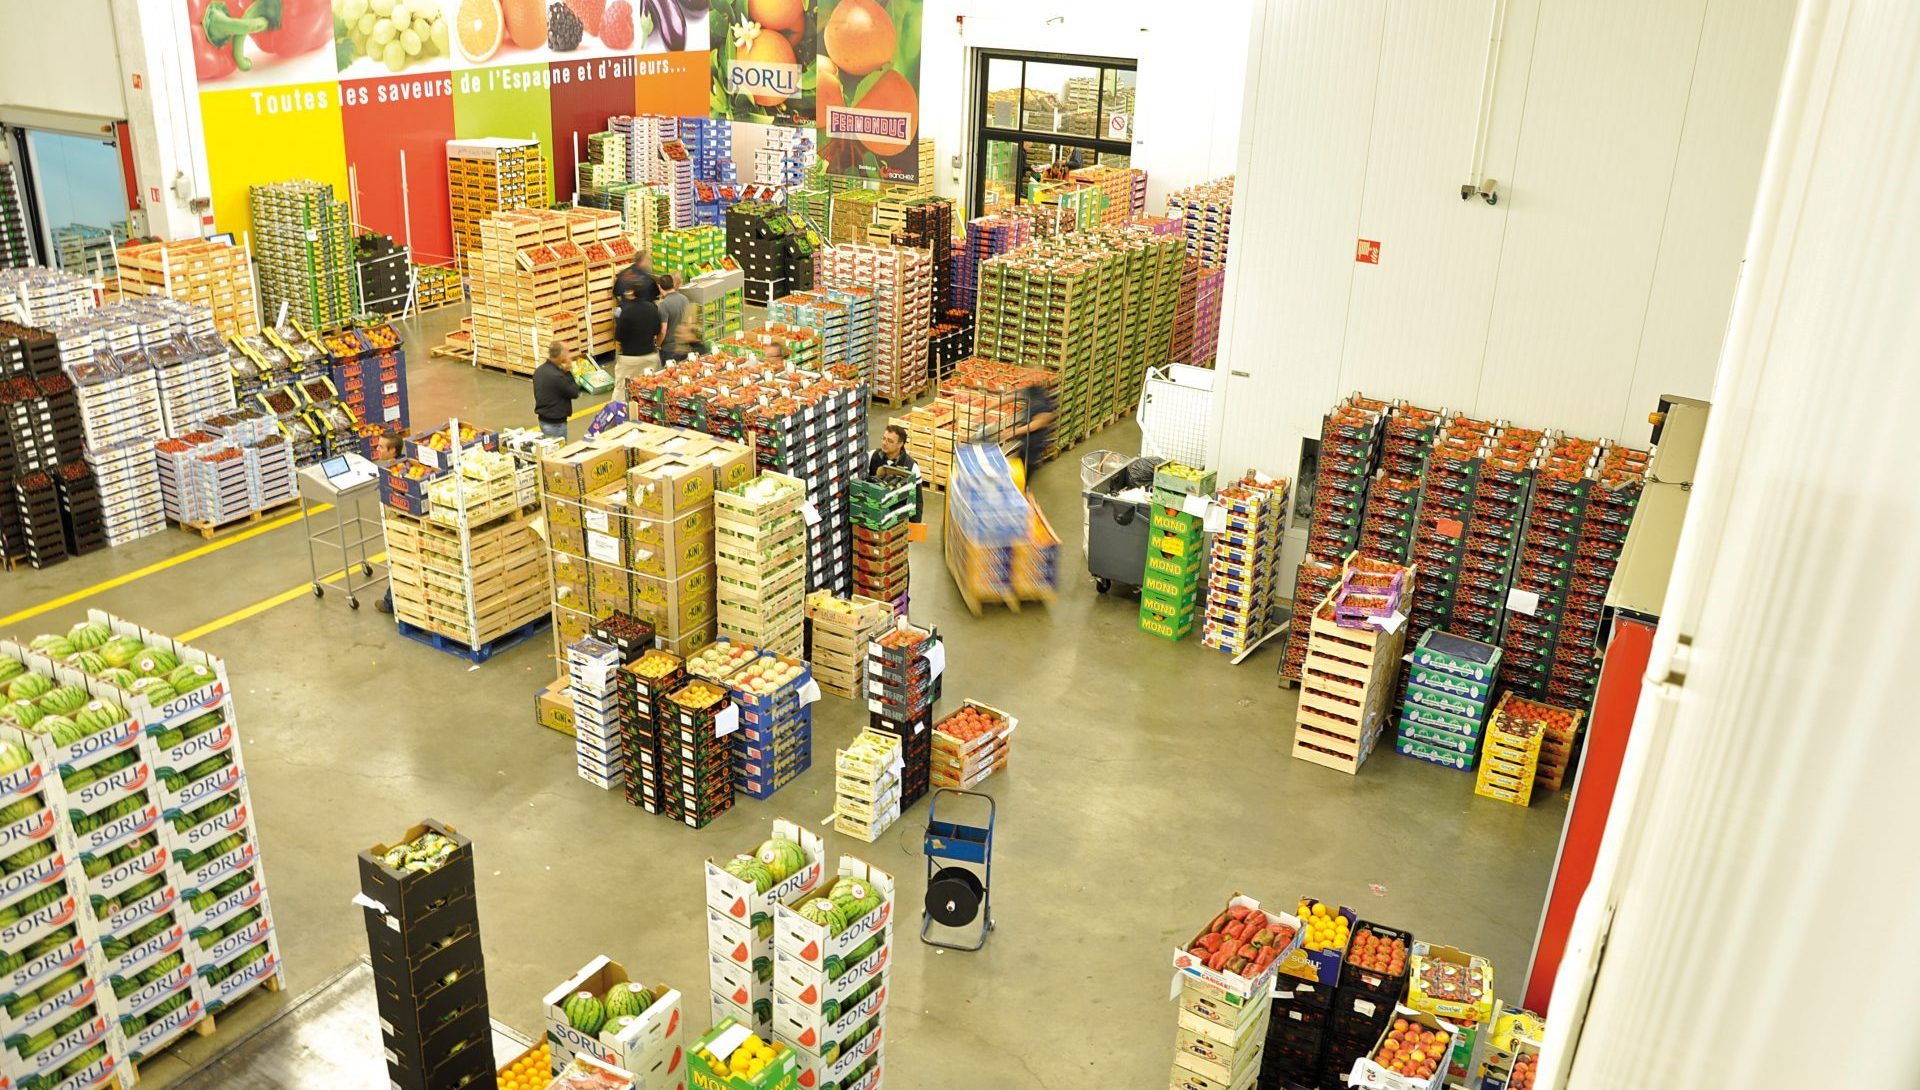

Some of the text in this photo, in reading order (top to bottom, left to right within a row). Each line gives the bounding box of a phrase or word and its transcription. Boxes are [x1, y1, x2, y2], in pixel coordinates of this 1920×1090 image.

[252, 89, 329, 116] Toutes
[338, 82, 369, 107] les
[378, 77, 453, 103] saveurs
[460, 73, 481, 95] de
[489, 64, 571, 92] l'Espagne
[578, 62, 592, 81] et
[732, 66, 798, 95] SORLI
[1154, 515, 1187, 533] MOND
[1150, 558, 1182, 576] MOND
[1147, 578, 1178, 596] MOND
[1144, 599, 1176, 617] MOND
[1142, 618, 1173, 637] MOND
[163, 684, 216, 719] SORLI
[70, 723, 130, 760] SORLI
[172, 726, 224, 762] SORLI
[0, 767, 31, 796] RLI
[80, 766, 140, 804] SORLI
[180, 770, 231, 804] SORLI
[0, 813, 43, 847] ORLI
[91, 809, 149, 847] SORLI
[188, 809, 240, 844] SORLI
[101, 852, 160, 889] SORLI
[197, 848, 248, 883] SORLI
[205, 885, 255, 921] SORLI
[767, 866, 814, 906] SORLI
[2, 901, 65, 943] SORLI
[111, 891, 168, 930] SORLI
[840, 907, 886, 948] SORLI
[119, 930, 176, 970] SORLI
[213, 923, 262, 959] SORLI
[13, 943, 75, 986] SORLI
[220, 959, 268, 995] SORLI
[838, 950, 883, 992] SORLI
[24, 984, 85, 1027] SORLI
[129, 969, 186, 1008] SORLI
[138, 1006, 193, 1046] SORLI
[836, 992, 880, 1035] SORLI
[36, 1024, 95, 1068] SORLI
[556, 1023, 606, 1060] SORLI
[834, 1032, 877, 1075] SORLI
[59, 1061, 104, 1090] ORLI
